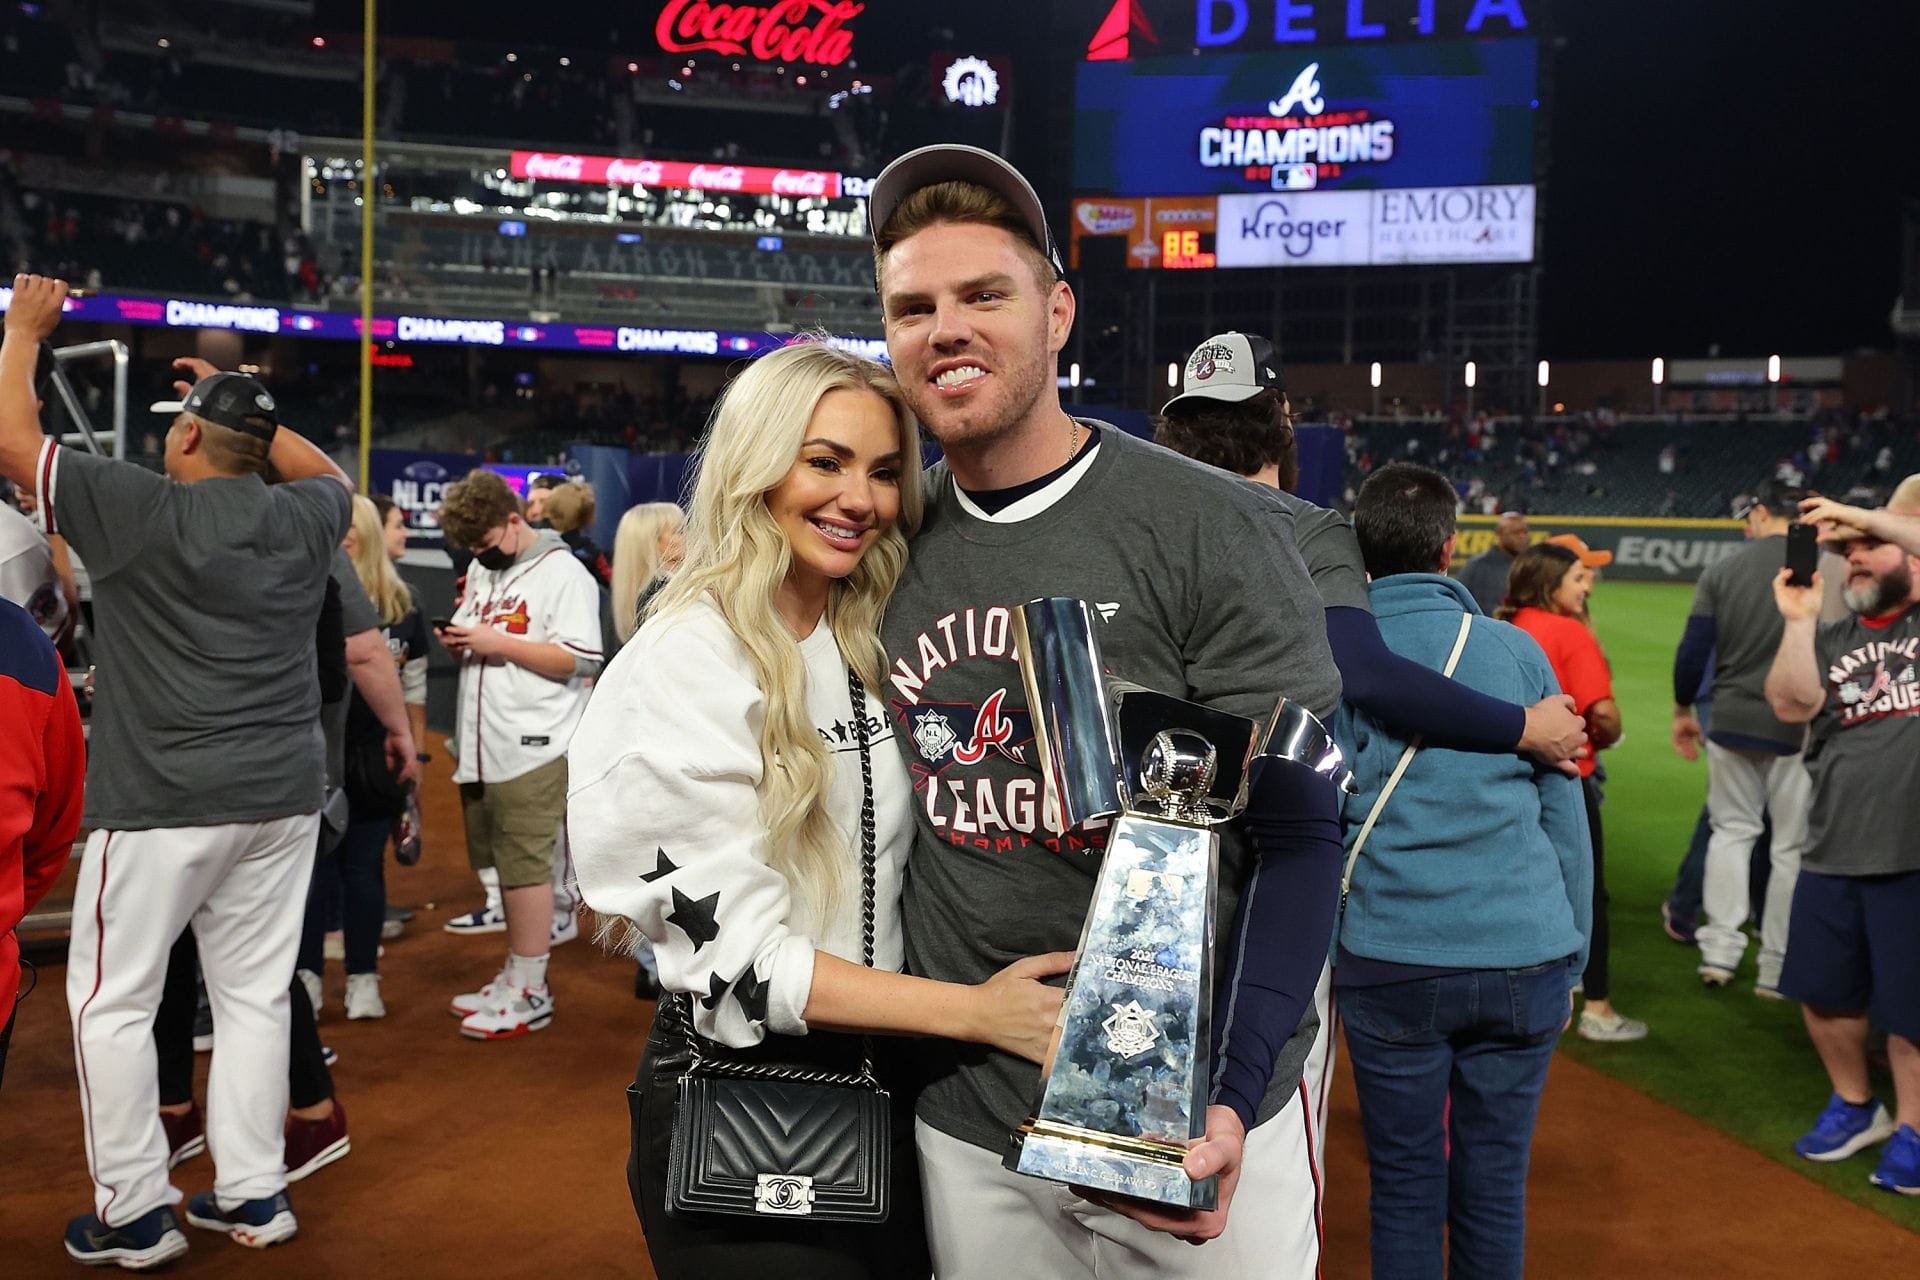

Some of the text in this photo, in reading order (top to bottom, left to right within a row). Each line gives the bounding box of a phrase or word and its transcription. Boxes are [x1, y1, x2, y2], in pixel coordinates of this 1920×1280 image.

[1200, 120, 1394, 168] CHAMPIONS
[1381, 188, 1527, 224] EMORY
[1163, 230, 1199, 257] 86
[1240, 201, 1347, 258] Kroger
[580, 243, 707, 278] AARON
[726, 250, 872, 284] TERRAC
[166, 300, 279, 333] CHAMPIONS
[398, 316, 504, 345] CHAMPIONS
[617, 327, 718, 355] CHAMPIONS
[890, 606, 1019, 706] NATIO
[926, 775, 1109, 835] LEAGU
[1104, 970, 1174, 993] CHAMPIONS
